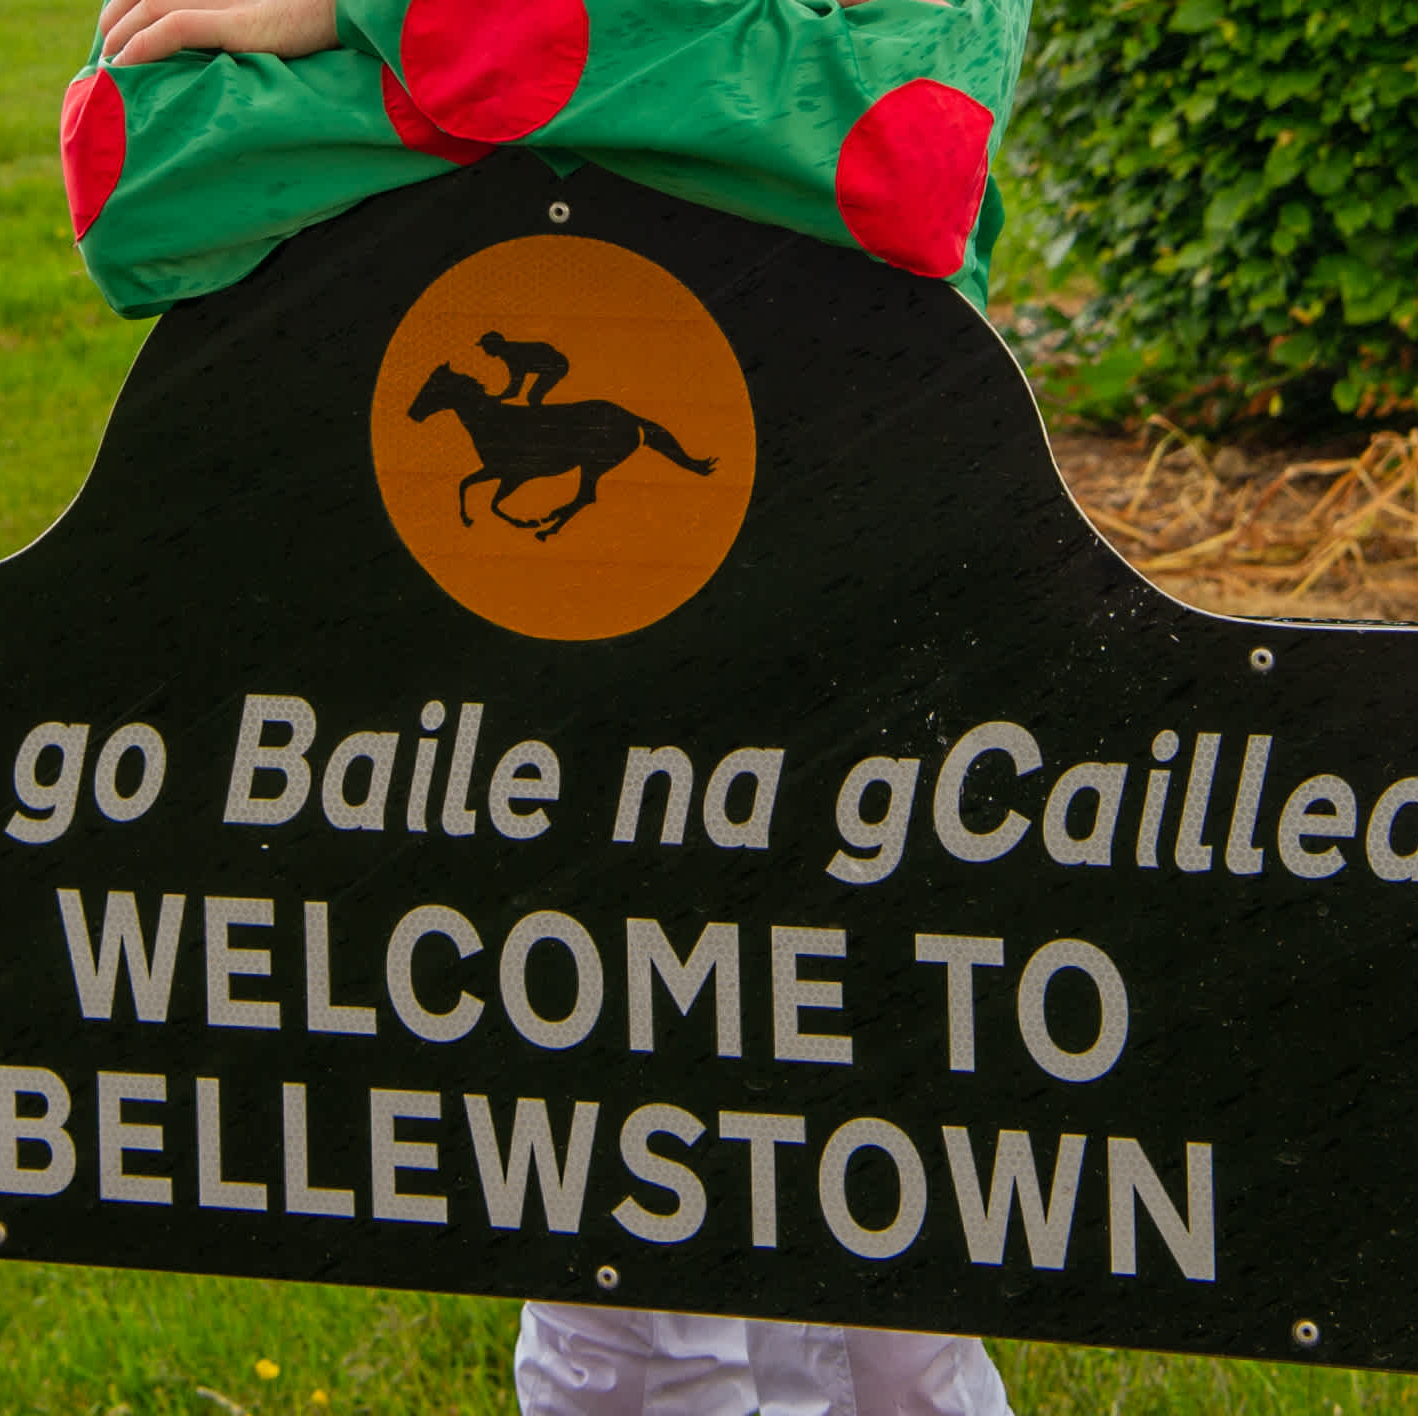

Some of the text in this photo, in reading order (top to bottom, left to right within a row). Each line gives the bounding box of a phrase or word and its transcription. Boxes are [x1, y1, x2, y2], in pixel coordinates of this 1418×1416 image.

[5, 722, 166, 843] go
[224, 695, 560, 838] Baile
[613, 746, 784, 848] na
[57, 888, 1128, 1081] WELCOME TO
